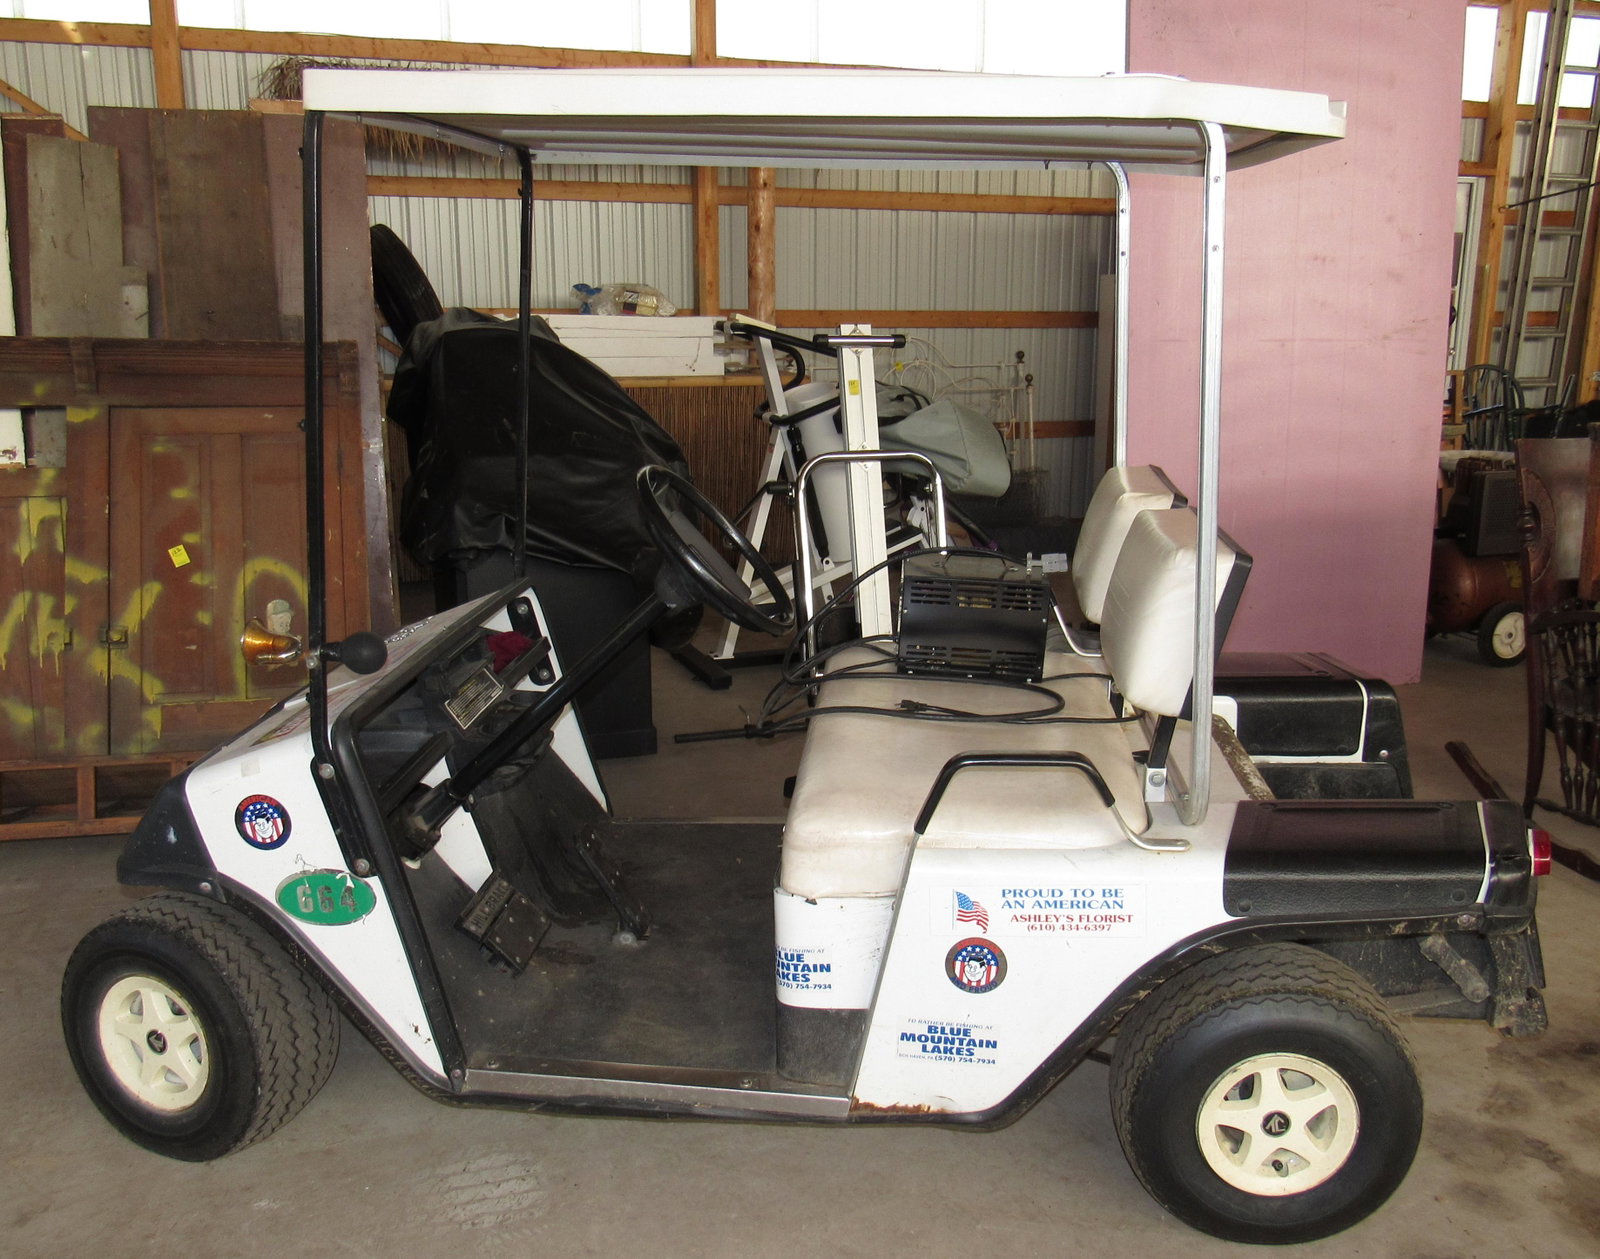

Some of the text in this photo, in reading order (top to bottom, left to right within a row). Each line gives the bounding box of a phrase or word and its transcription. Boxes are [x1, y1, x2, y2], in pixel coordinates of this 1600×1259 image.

[1001, 888, 1124, 898] PROUD TO BE
[296, 885, 356, 913] 664
[1001, 899, 1124, 909] AN AMERICAN
[1010, 914, 1134, 923] ASHLEY'S FLORIST
[1027, 923, 1112, 932] (610) 434-6397
[927, 1025, 972, 1037] BLUE
[900, 1032, 998, 1049] MOUNTAIN
[921, 1043, 975, 1056] LAKES
[934, 1054, 956, 1063] (570)
[958, 1056, 996, 1065] 754-7934
